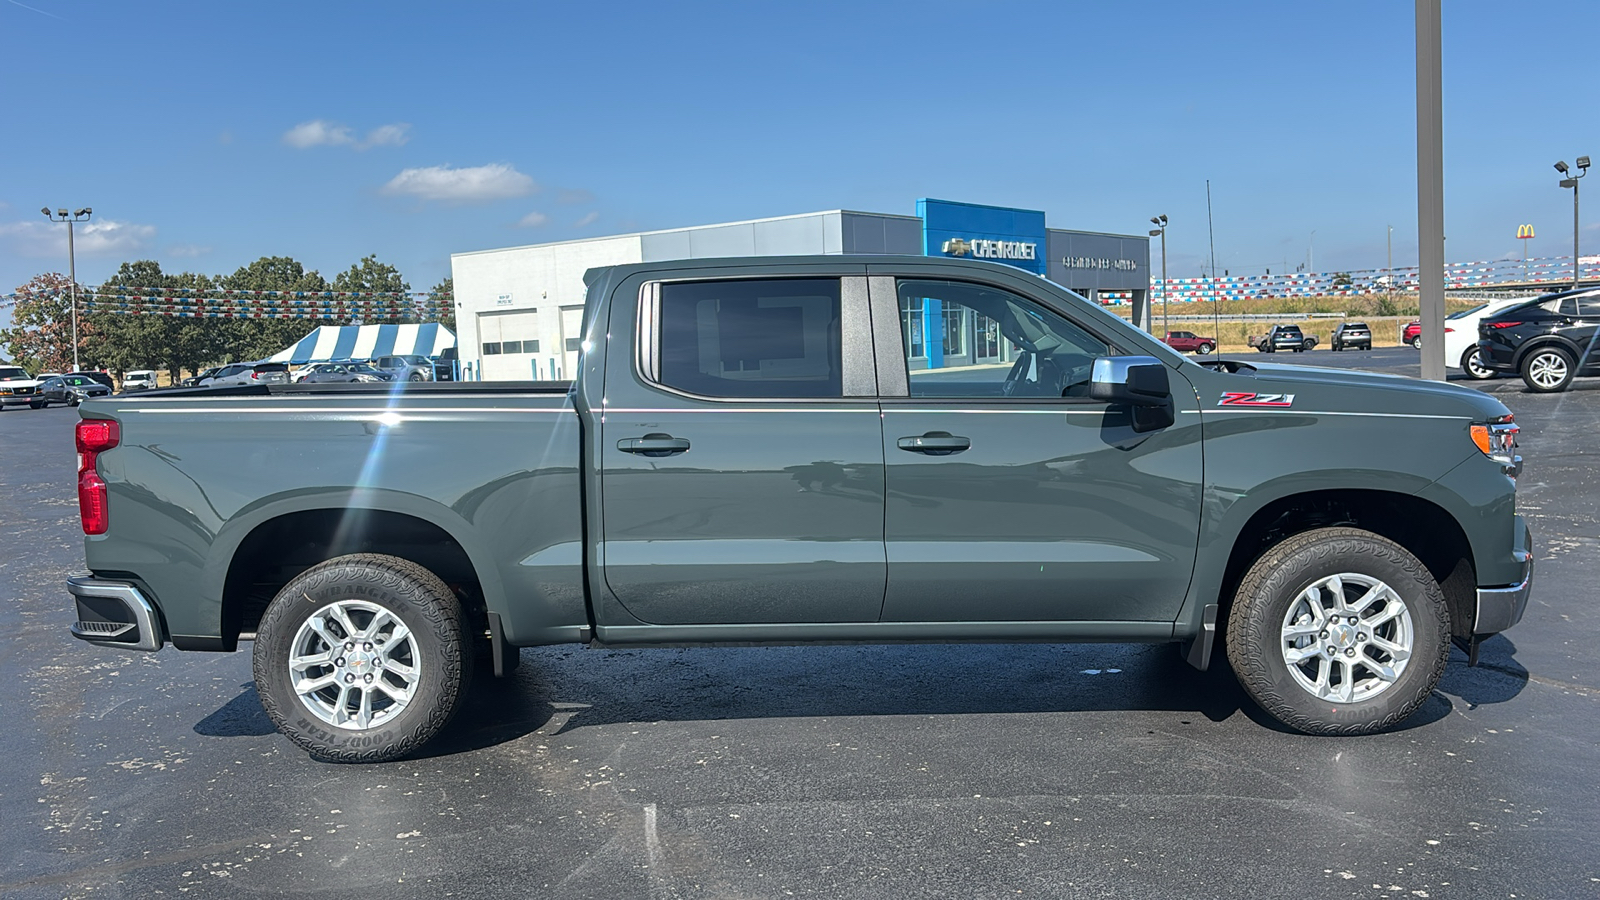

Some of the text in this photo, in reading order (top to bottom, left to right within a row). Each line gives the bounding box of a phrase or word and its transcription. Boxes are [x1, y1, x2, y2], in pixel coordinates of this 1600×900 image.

[971, 239, 1037, 260] CHEVROLET
[1217, 391, 1296, 407] Z71
[315, 584, 409, 614] WRANGLER
